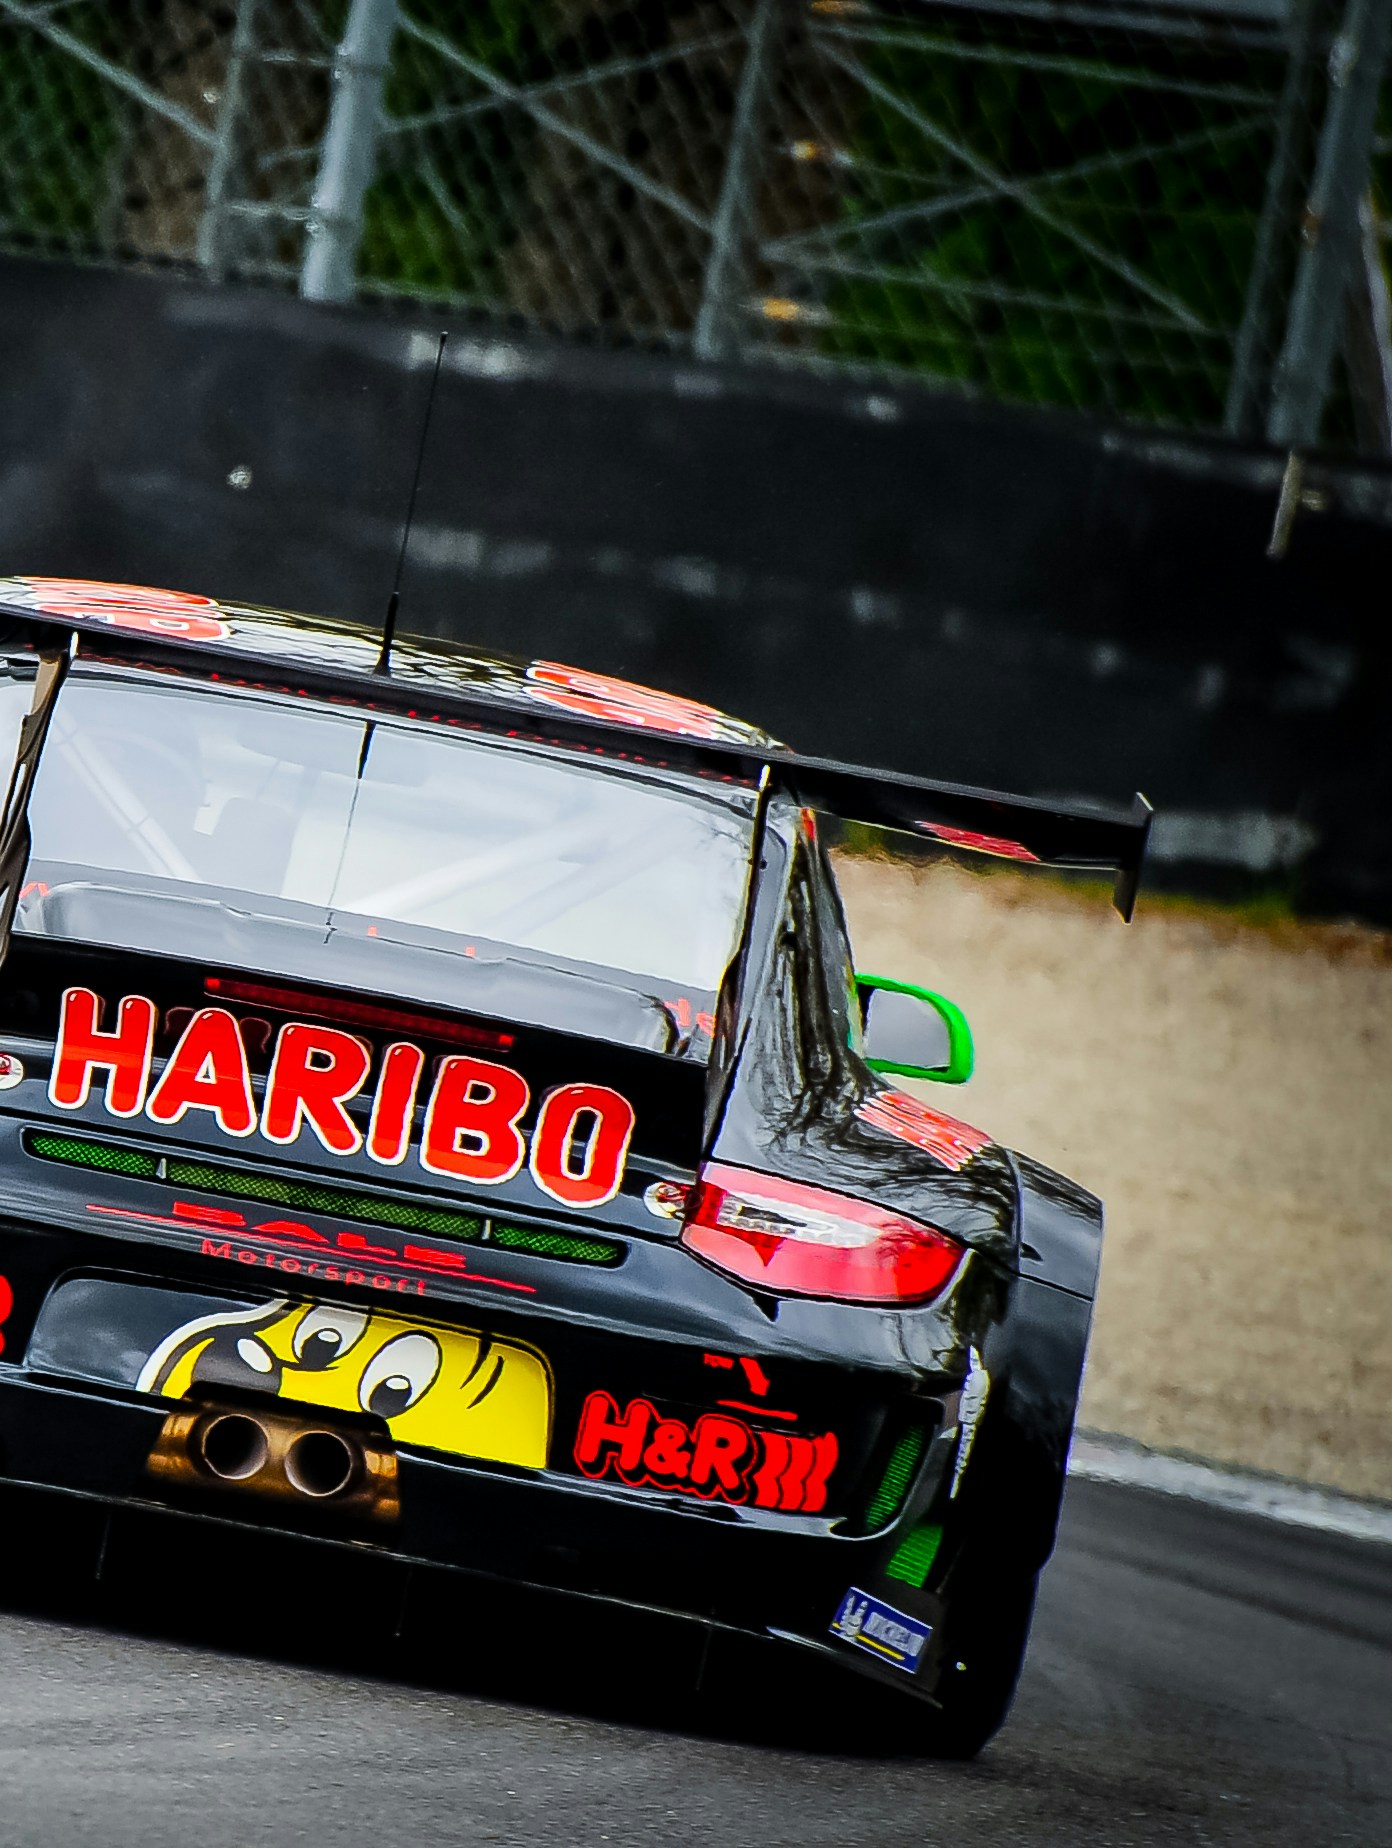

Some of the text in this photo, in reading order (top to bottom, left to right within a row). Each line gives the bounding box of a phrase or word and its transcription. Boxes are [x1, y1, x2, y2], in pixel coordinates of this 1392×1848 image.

[47, 987, 636, 1209] HARIBO
[201, 1239, 427, 1296] Motorsport
[574, 1390, 757, 1504] H&R
